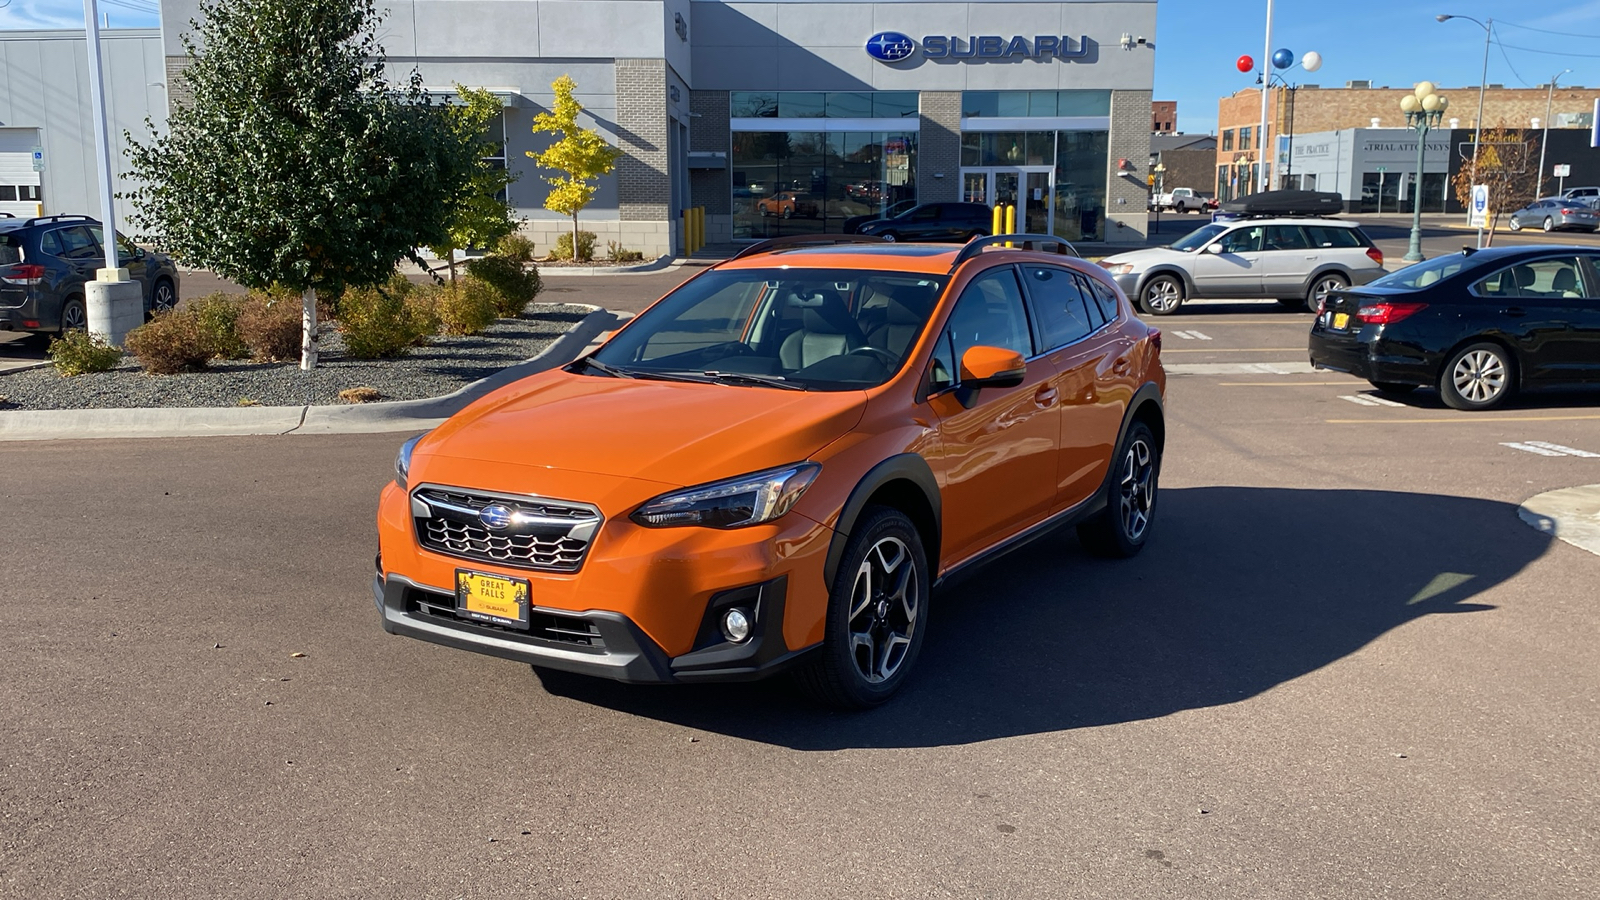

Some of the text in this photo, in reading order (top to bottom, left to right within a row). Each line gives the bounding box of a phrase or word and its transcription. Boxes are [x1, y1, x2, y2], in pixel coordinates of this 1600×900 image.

[922, 35, 1088, 59] SUBARU
[1468, 133, 1486, 142] Te
[1295, 146, 1304, 156] THE
[1368, 143, 1396, 152] TRIAL
[480, 579, 505, 590] GREAT
[480, 588, 505, 600] FALLS
[485, 604, 508, 613] SUBARU
